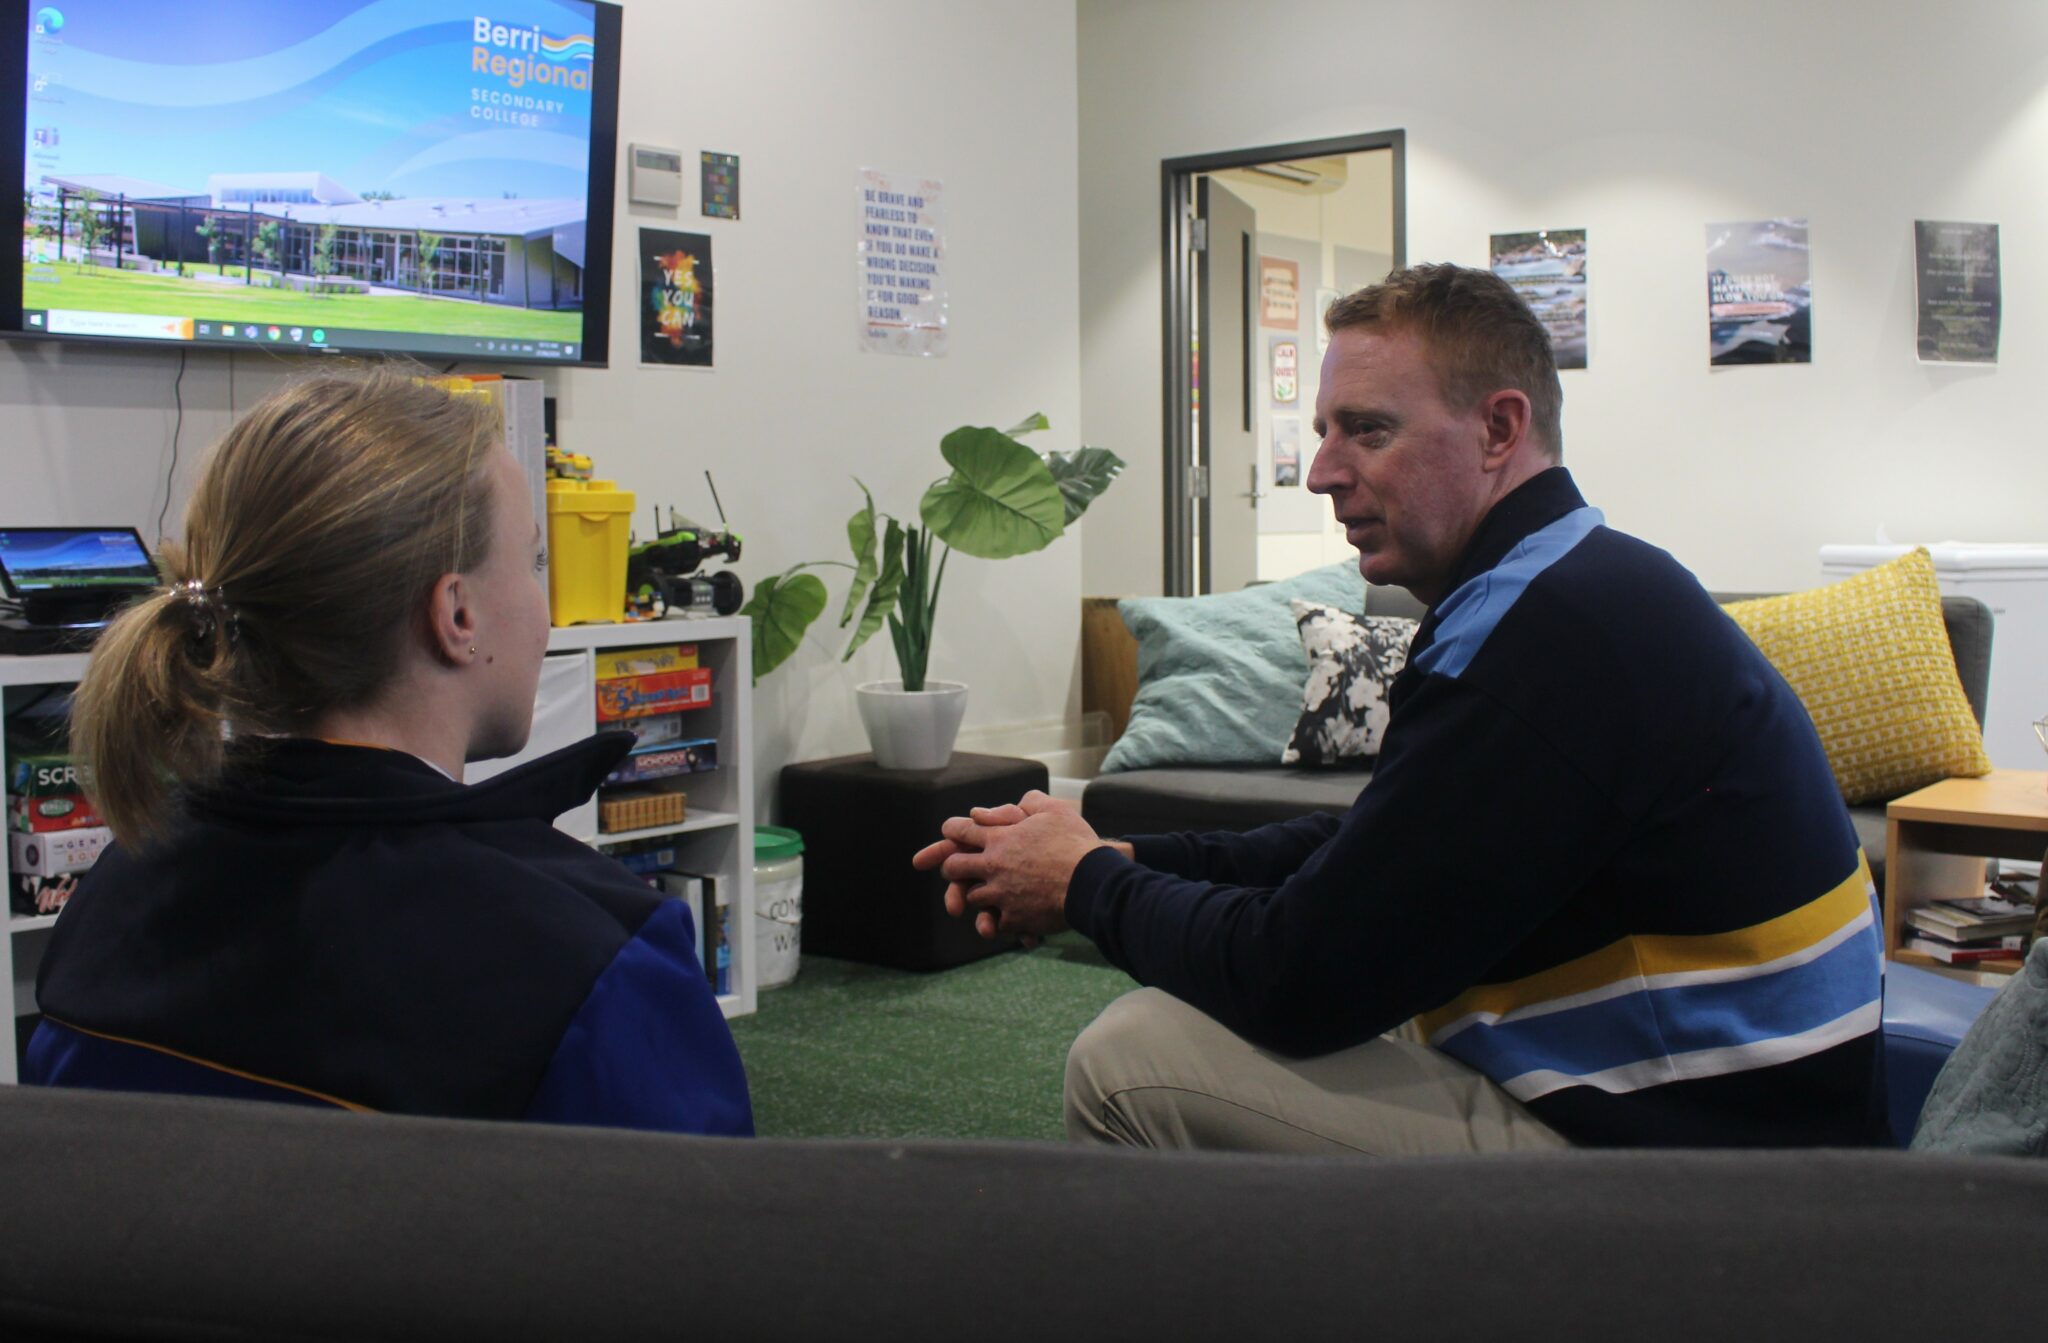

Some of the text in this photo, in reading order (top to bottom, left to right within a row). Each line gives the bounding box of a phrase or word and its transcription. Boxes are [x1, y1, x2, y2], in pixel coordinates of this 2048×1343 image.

[473, 15, 540, 53] Berri
[472, 46, 593, 91] Regional
[471, 87, 565, 113] SECONDARY
[470, 105, 539, 127] COLLEGE
[864, 189, 924, 208] BE BRAVE AND
[865, 206, 918, 224] FEARLESS TO
[865, 223, 890, 237] KNOW
[892, 226, 912, 240] THAT
[876, 241, 892, 254] YOU
[895, 243, 906, 256] DO
[909, 245, 931, 258] MAKE
[933, 248, 939, 258] A
[866, 256, 896, 271] WRONG
[663, 269, 695, 286] YES
[899, 277, 931, 291] MAKING
[660, 288, 695, 308] YOU
[878, 290, 894, 303] FOR
[897, 293, 920, 306] GOOD
[660, 310, 695, 328] CAN
